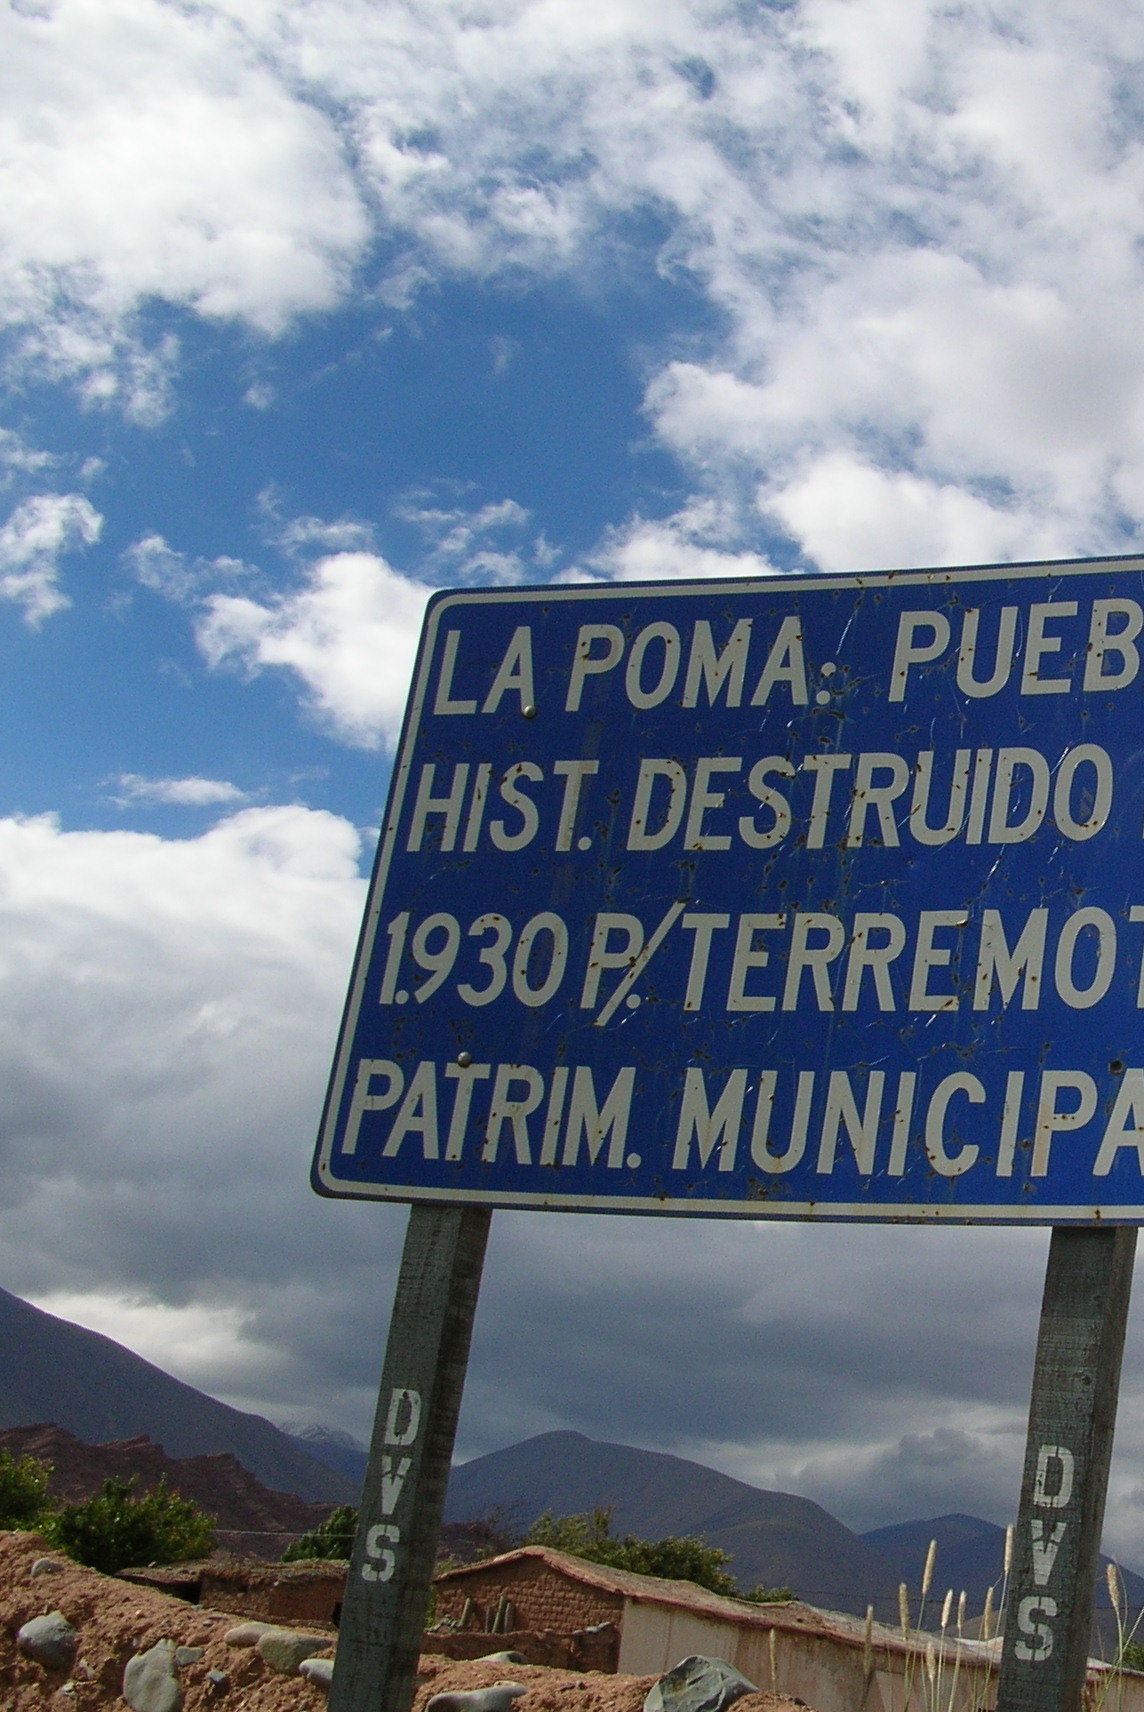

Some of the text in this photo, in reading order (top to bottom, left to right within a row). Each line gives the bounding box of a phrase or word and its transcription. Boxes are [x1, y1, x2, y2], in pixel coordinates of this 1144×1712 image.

[433, 626, 537, 716] LA
[565, 616, 837, 713] POMA:
[406, 759, 600, 853] HIST.
[627, 743, 1114, 851] DESTRUIDO
[379, 911, 570, 1007] 1.930
[341, 1058, 643, 1169] PATRIM.
